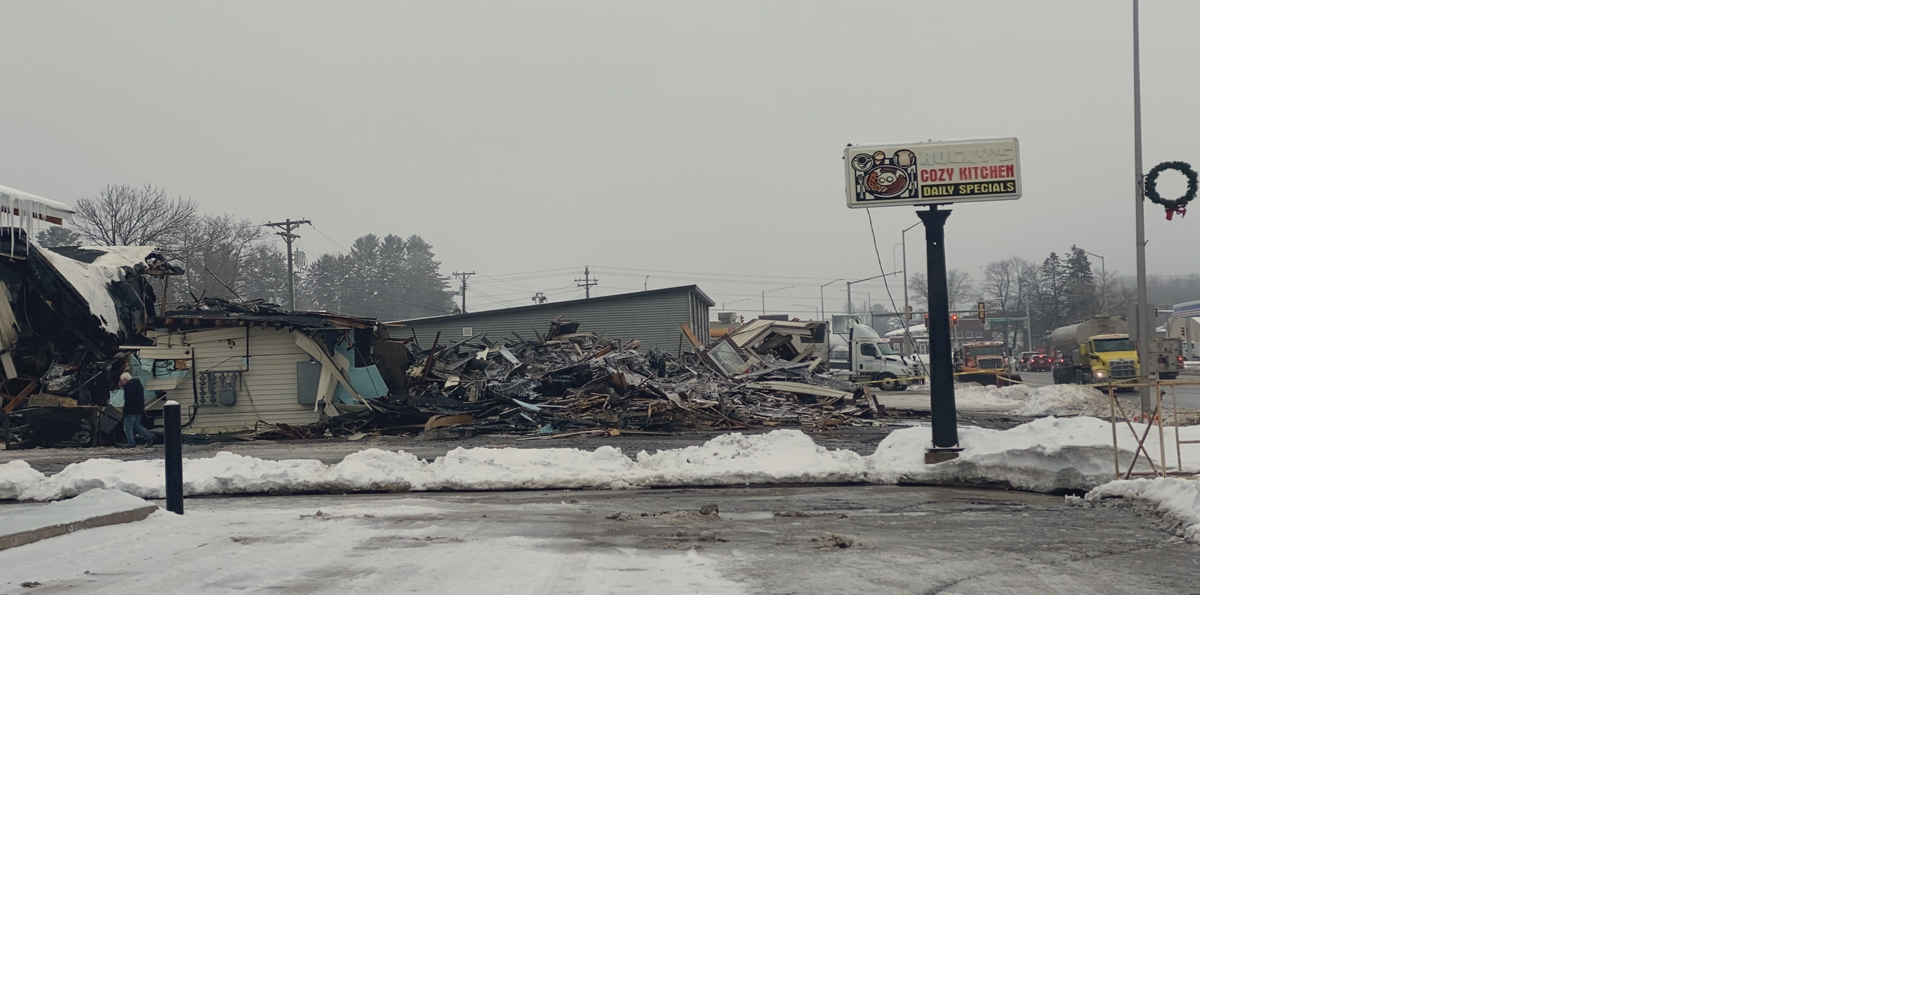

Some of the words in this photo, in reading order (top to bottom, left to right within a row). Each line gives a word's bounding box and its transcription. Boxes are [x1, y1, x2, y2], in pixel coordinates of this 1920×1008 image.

[920, 168, 954, 182] COZY
[959, 165, 1014, 180] KITCHEN
[923, 185, 954, 196] DAILY
[959, 182, 1014, 194] SPECIALS
